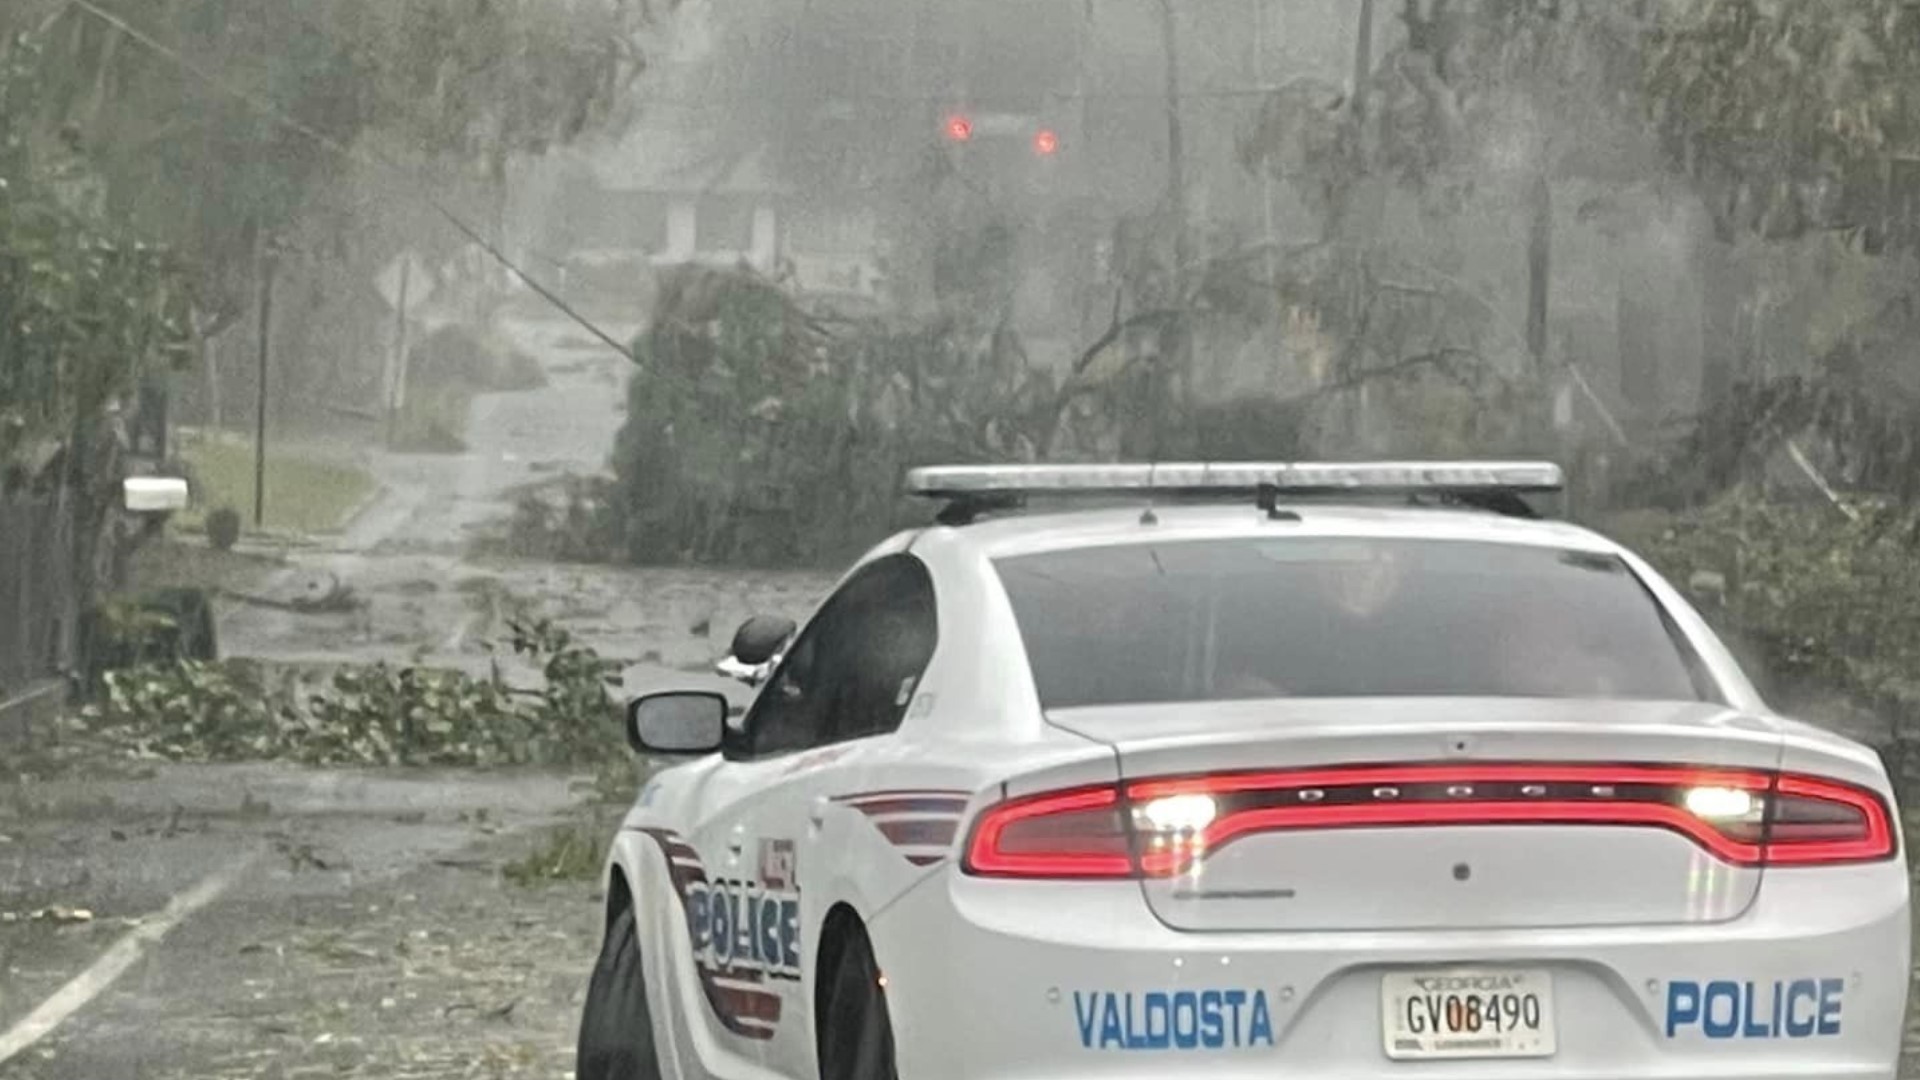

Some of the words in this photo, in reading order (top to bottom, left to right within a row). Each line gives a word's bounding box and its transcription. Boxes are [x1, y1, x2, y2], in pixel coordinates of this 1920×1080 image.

[688, 880, 800, 977] POLICE
[1074, 989, 1273, 1049] VALDOSTA
[1666, 978, 1844, 1038] POLICE
